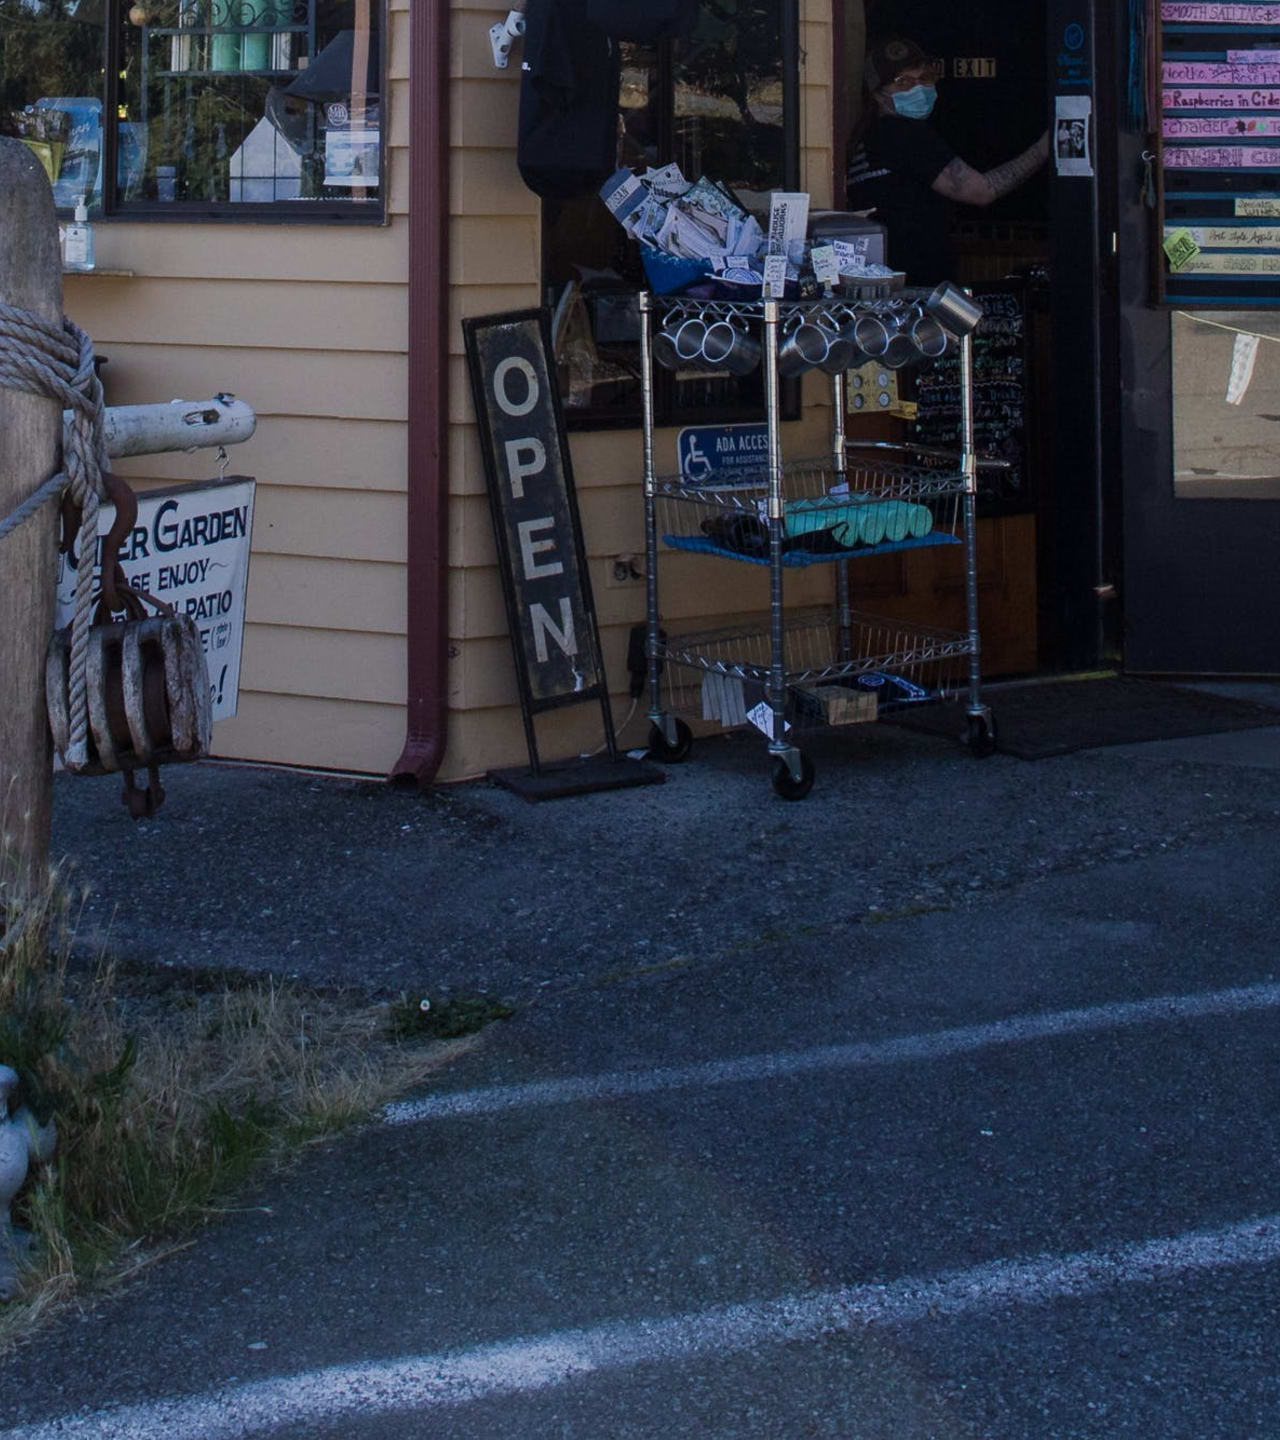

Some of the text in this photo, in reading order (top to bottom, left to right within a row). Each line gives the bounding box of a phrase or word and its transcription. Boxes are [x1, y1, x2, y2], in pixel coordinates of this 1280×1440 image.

[1210, 6, 1264, 21] SAILING
[956, 58, 995, 77] EXIT
[1173, 90, 1234, 108] Raspberries
[1239, 94, 1249, 106] in
[715, 434, 769, 453] ADA ACCES
[492, 356, 578, 664] OPEN
[154, 499, 249, 552] GARDEN
[158, 558, 210, 590] ENJOY
[186, 590, 233, 620] PATIO
